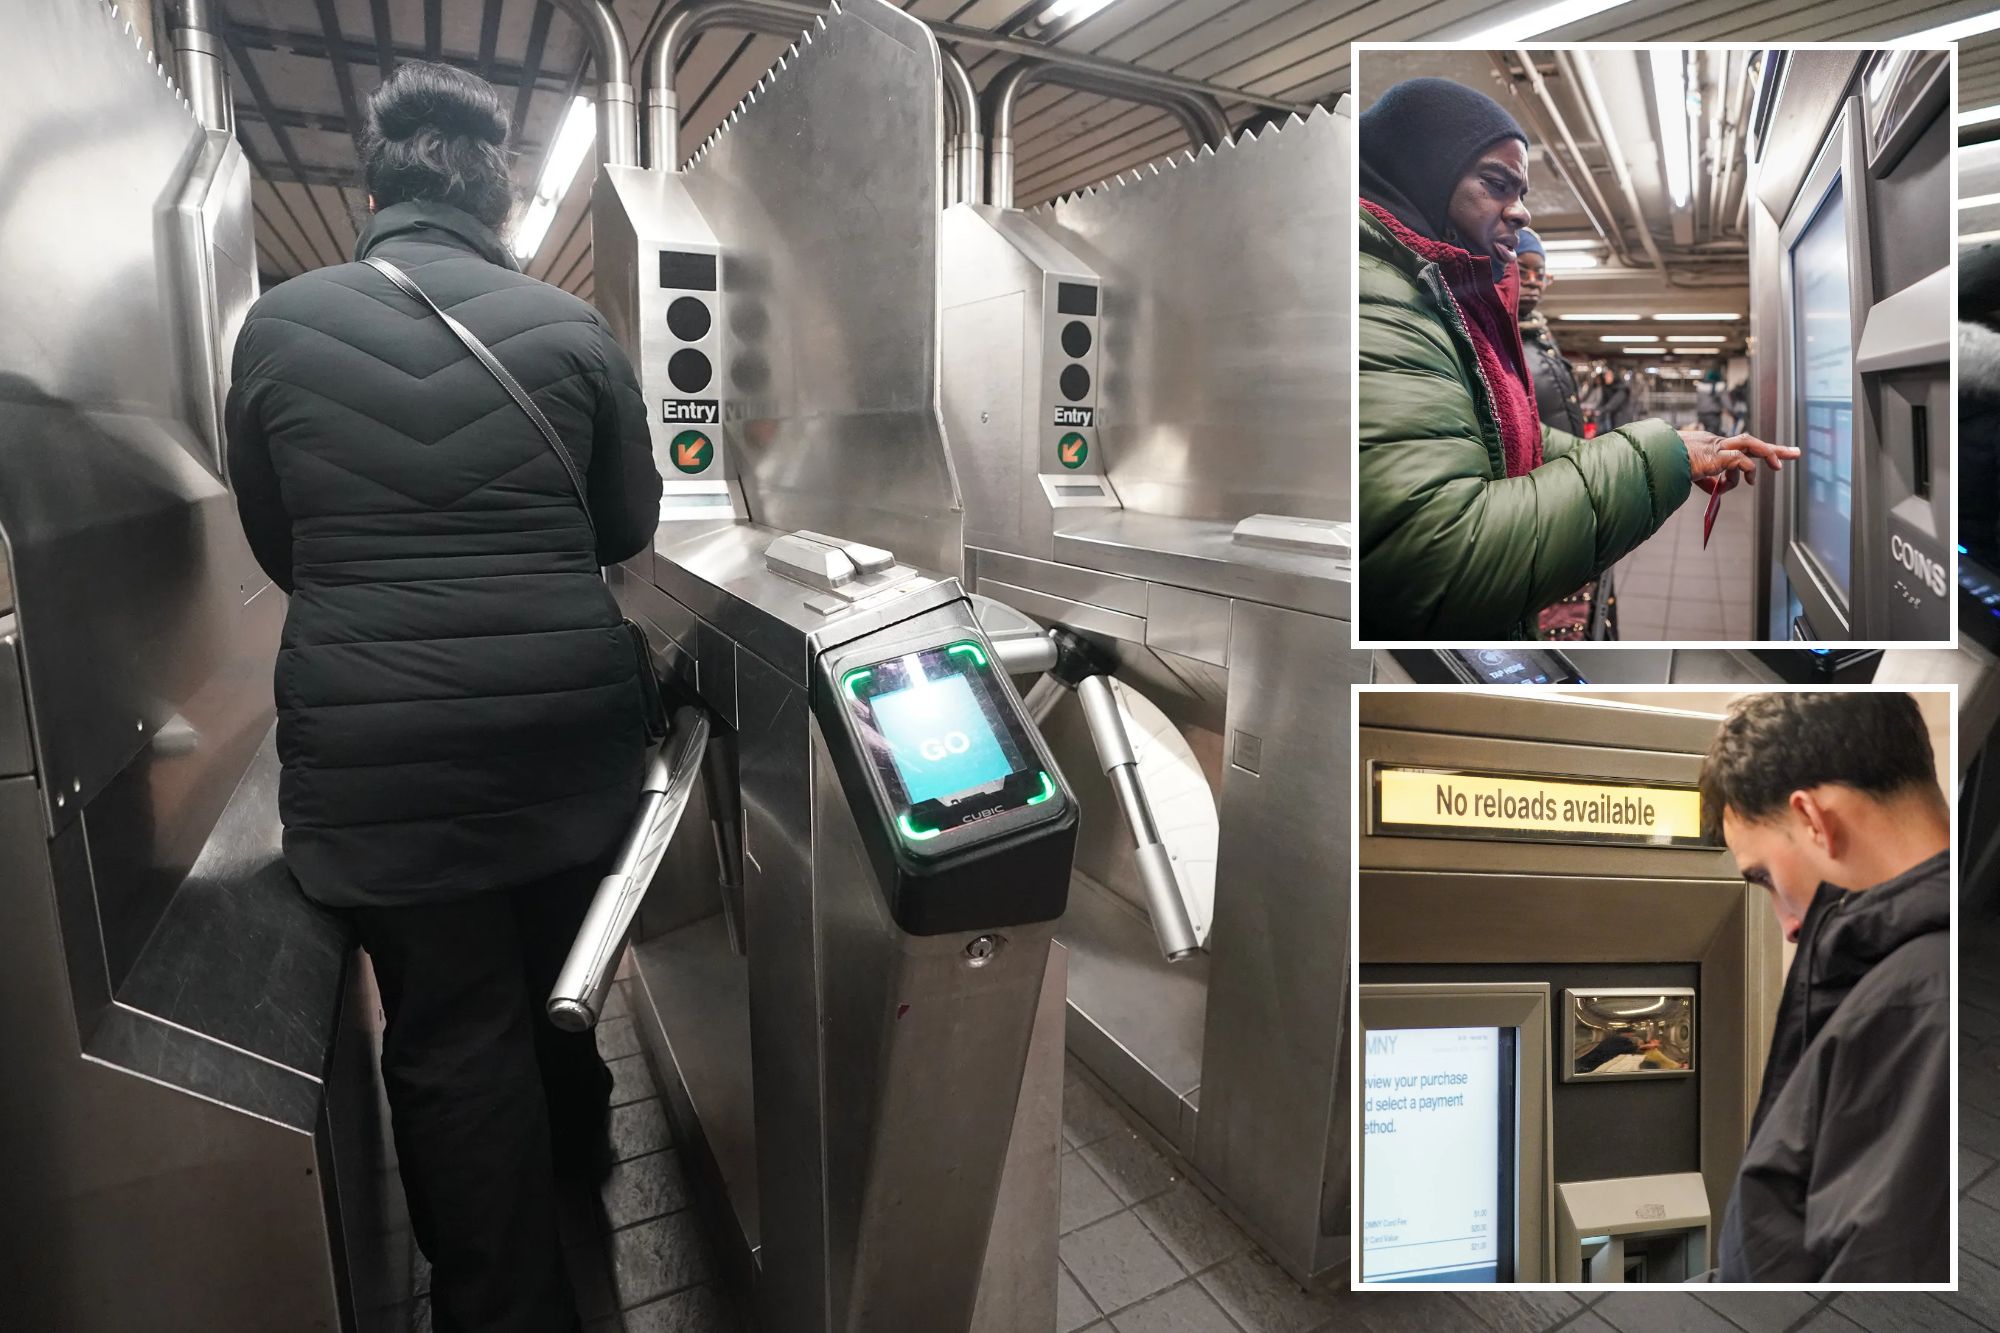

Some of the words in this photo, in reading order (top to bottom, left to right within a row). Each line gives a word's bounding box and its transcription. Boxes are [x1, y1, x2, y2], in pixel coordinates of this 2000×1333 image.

[663, 401, 717, 423] Entry
[1054, 407, 1092, 427] Entry
[1891, 534, 1947, 597] COINS
[1489, 669, 1504, 680] TAP
[920, 731, 971, 761] GO
[962, 804, 1005, 823] CUBIC
[1436, 784, 1468, 816] No
[1474, 788, 1557, 822] reloads
[1563, 793, 1655, 826] available
[1365, 1074, 1392, 1088] view
[1394, 1075, 1418, 1091] your
[1420, 1071, 1468, 1090] purchase
[1376, 1096, 1407, 1111] select
[1409, 1097, 1417, 1109] a
[1419, 1093, 1464, 1112] payment
